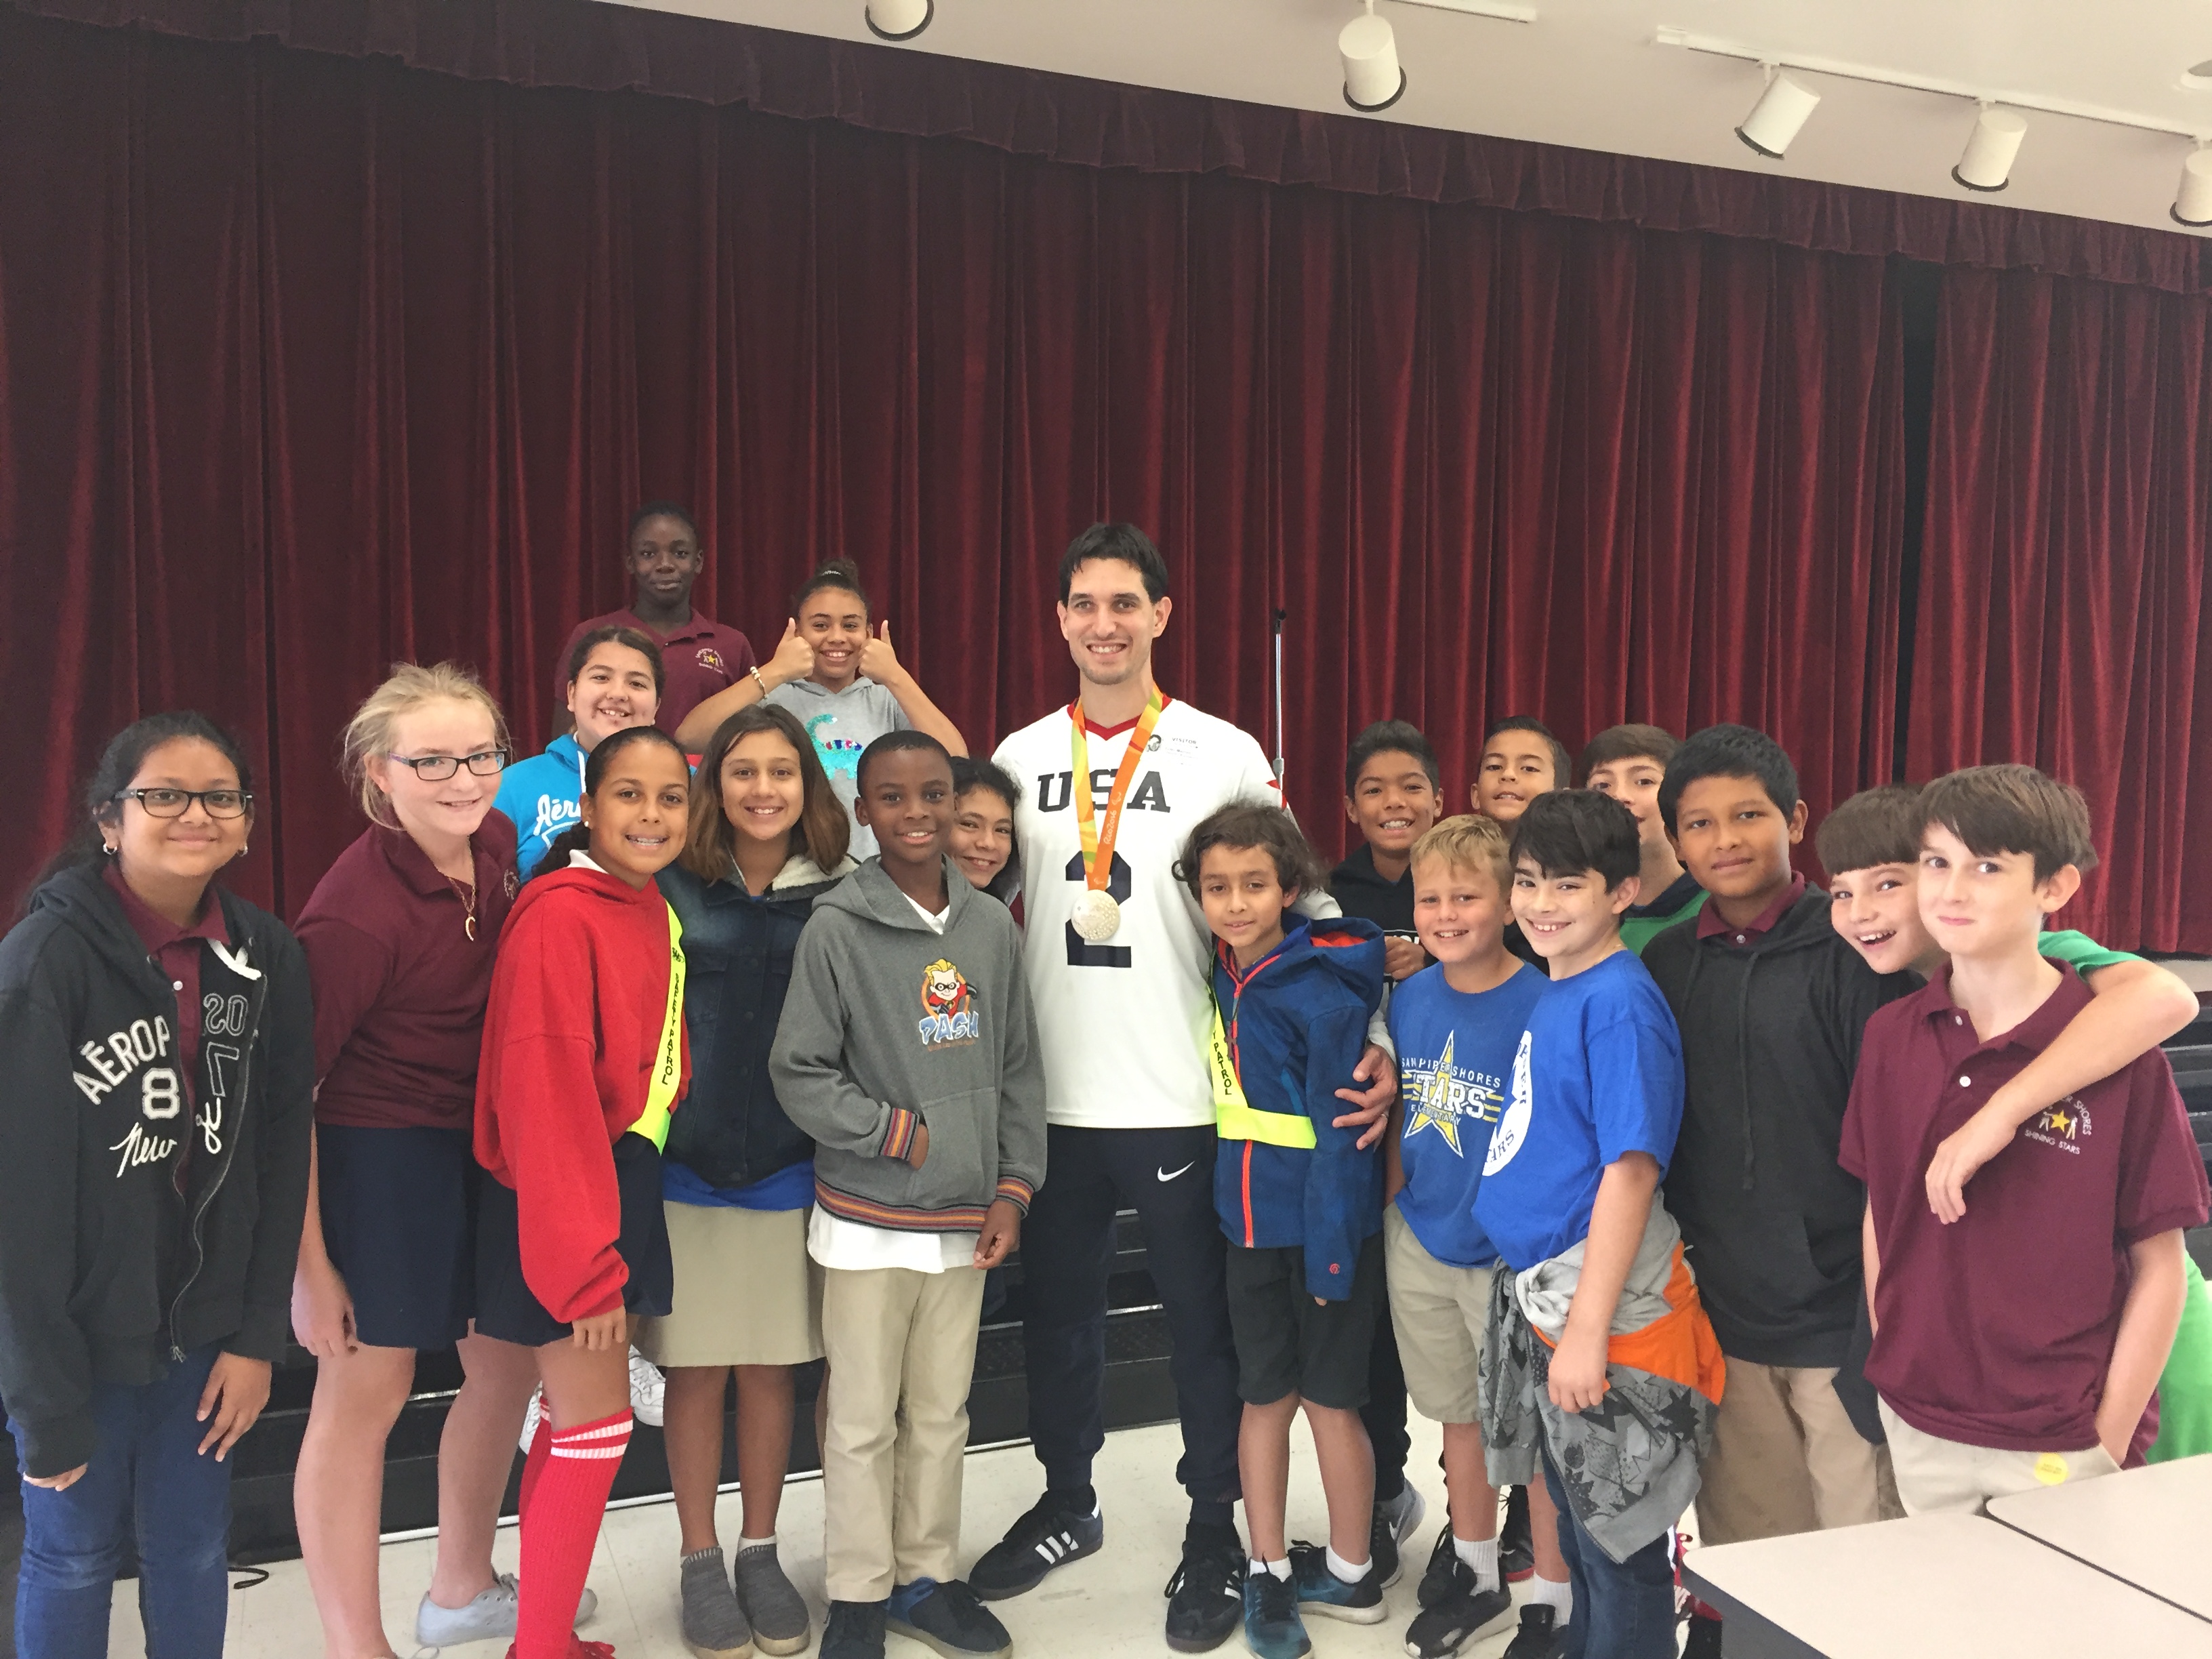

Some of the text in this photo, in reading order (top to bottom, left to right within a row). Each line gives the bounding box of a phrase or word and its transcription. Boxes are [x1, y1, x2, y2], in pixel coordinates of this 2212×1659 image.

[1172, 737, 1197, 745] VISITOR
[1038, 769, 1171, 813] USA
[1065, 851, 1132, 968] 2
[661, 1028, 674, 1086] PATROL
[1213, 1042, 1232, 1096] PATROL
[1452, 1065, 1501, 1088] SHORES
[142, 1067, 181, 1120] 8
[1410, 1103, 1462, 1126] ELEMENTARY
[1413, 1073, 1487, 1119] TARS
[2074, 1100, 2092, 1136] SHORES
[2058, 1141, 2081, 1155] STARS
